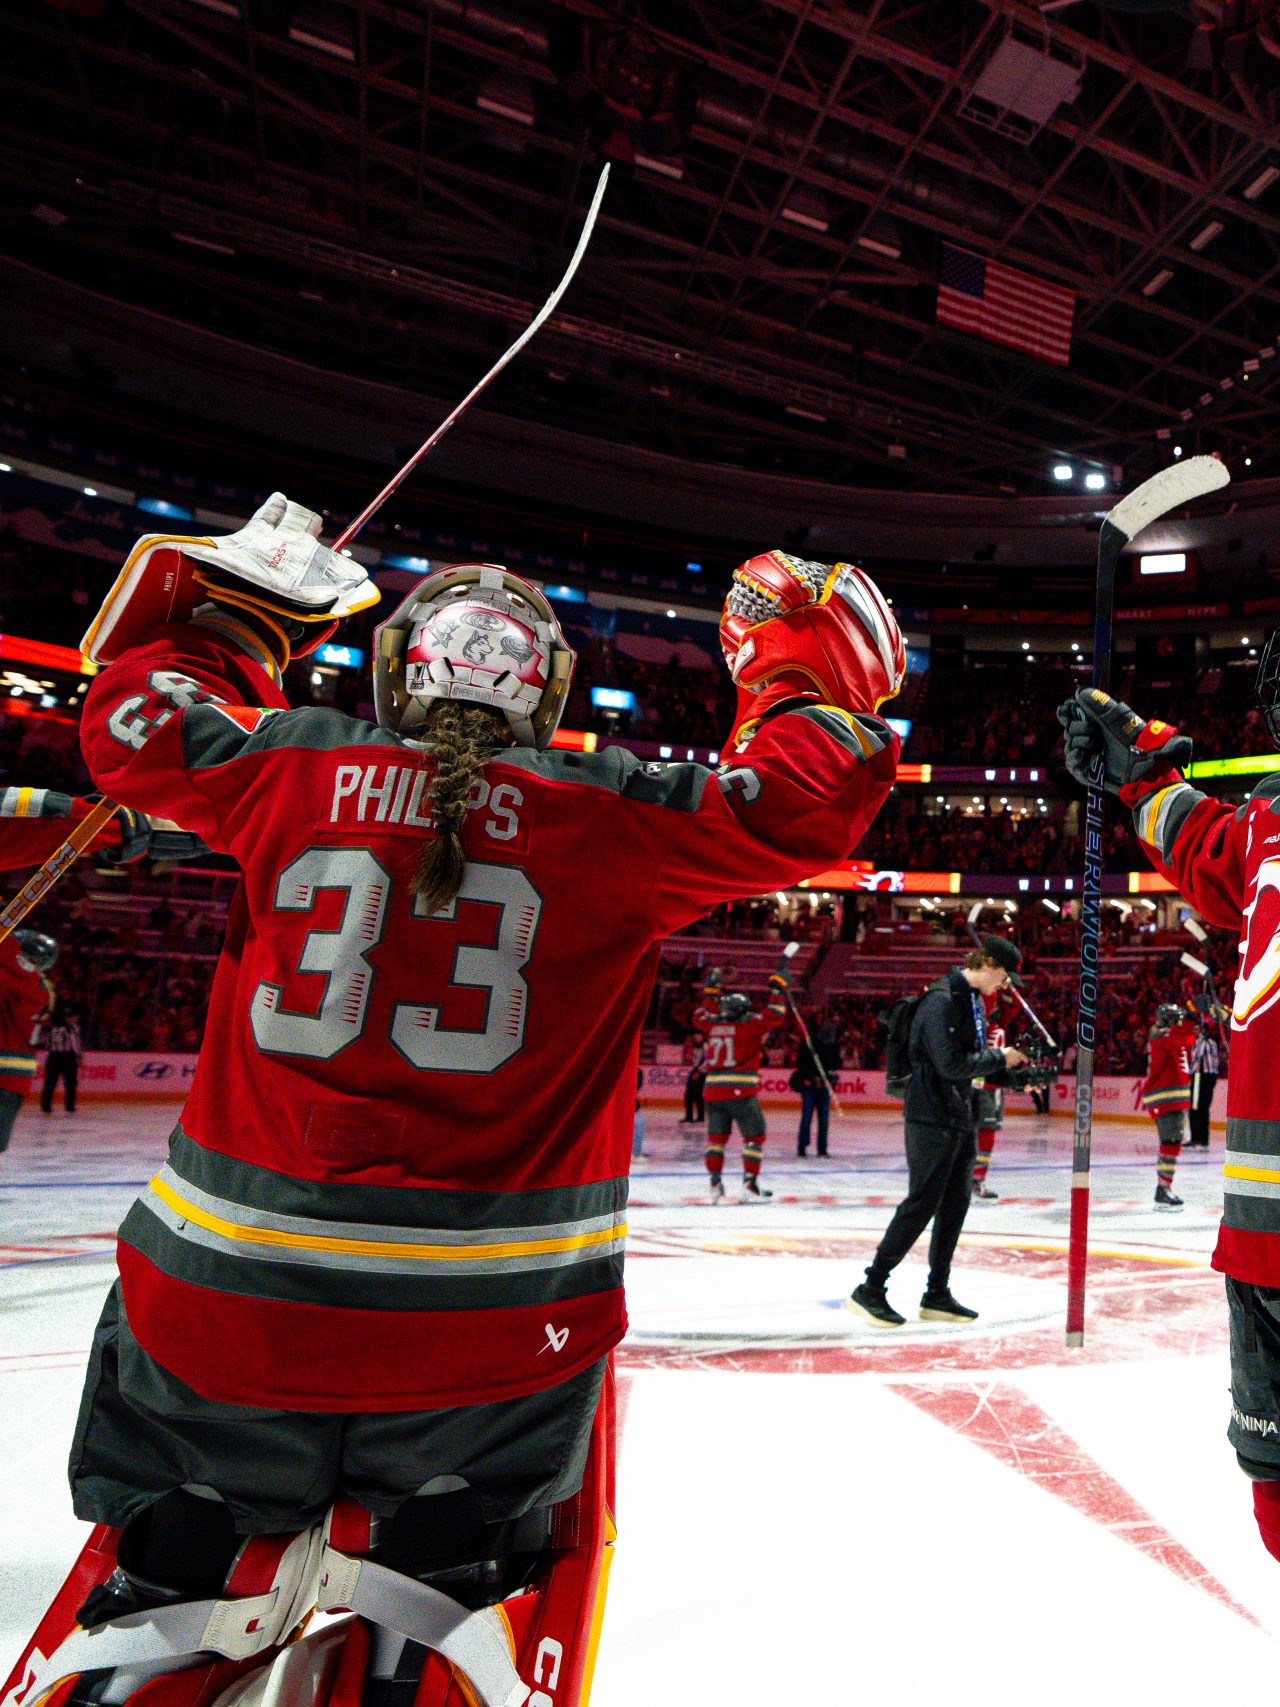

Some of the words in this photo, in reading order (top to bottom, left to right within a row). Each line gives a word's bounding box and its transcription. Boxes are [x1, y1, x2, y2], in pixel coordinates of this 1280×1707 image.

[330, 765, 523, 841] PHILPS
[0, 841, 77, 928] CCM
[248, 846, 545, 1076] 33
[1240, 1412, 1279, 1437] NINJA
